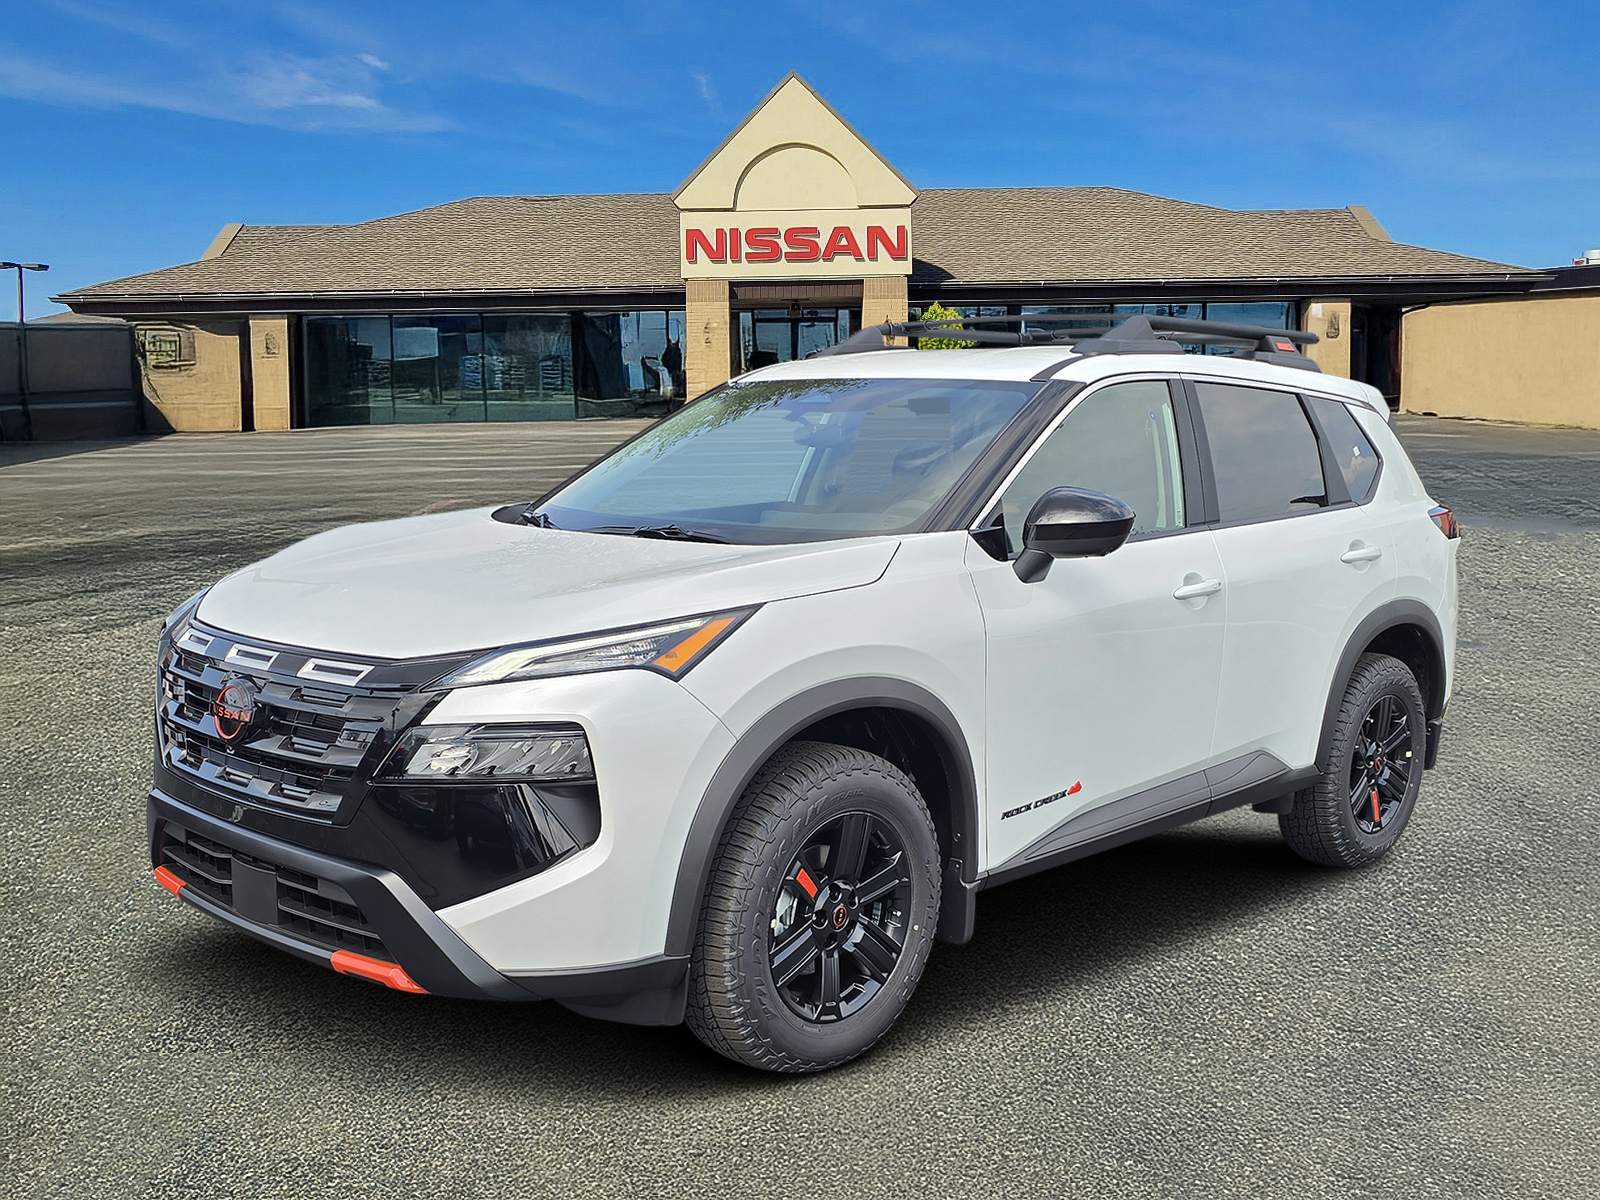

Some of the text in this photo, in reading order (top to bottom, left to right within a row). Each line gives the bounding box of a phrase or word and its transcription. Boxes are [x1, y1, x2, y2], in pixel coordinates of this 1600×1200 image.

[686, 225, 908, 263] NISSAN
[1001, 789, 1068, 820] ROCK CREEK
